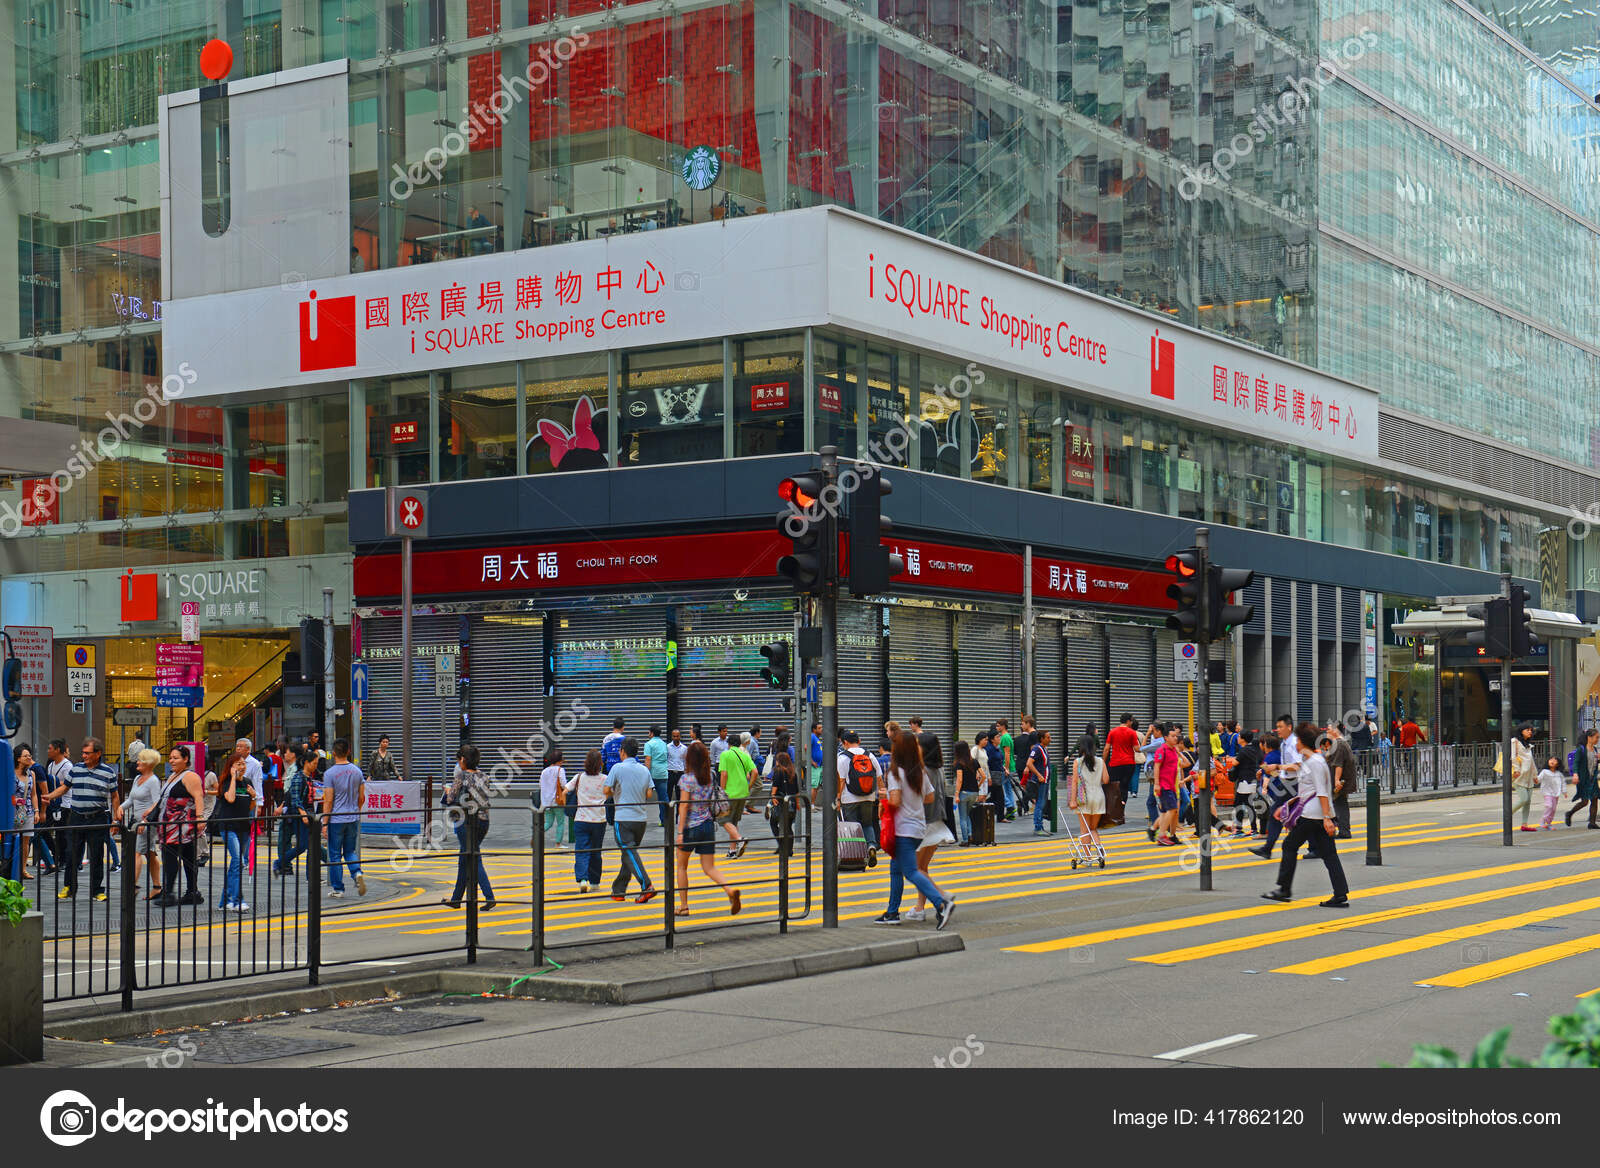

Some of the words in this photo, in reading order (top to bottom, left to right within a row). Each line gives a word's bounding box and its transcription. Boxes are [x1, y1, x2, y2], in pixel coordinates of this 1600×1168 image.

[364, 260, 666, 330] 國際廣場購物中心
[869, 253, 874, 298] i
[885, 263, 970, 326] SQUARE
[980, 296, 1052, 358] Shopping
[1056, 321, 1107, 365] Centre
[411, 330, 416, 354] i
[424, 322, 505, 354] SQUARE
[515, 315, 596, 342] Shopping
[601, 309, 665, 329] Centre
[756, 387, 784, 399] 周大福
[1213, 364, 1359, 440] 國際廣場購物中心
[1072, 434, 1092, 458] 周大
[481, 552, 559, 583] 周大福
[576, 558, 605, 568] CHOW
[609, 556, 625, 566] TAI
[629, 555, 658, 565] FOOK
[928, 559, 946, 570] CHOW
[947, 561, 956, 571] TAI
[957, 563, 974, 572] FOOK
[165, 572, 170, 599] i
[179, 570, 260, 600] SQUARE
[1048, 565, 1087, 593] 周大福
[205, 601, 260, 617] 國際廣場
[562, 640, 608, 651] FRANCK
[614, 638, 663, 650] MULLER
[686, 635, 735, 647] FRANCK
[741, 633, 793, 645] MULLER
[370, 647, 403, 658] FRANC
[70, 671, 80, 679] 24
[81, 671, 92, 679] hrs
[73, 682, 90, 693] 全日
[440, 684, 453, 694] 全日
